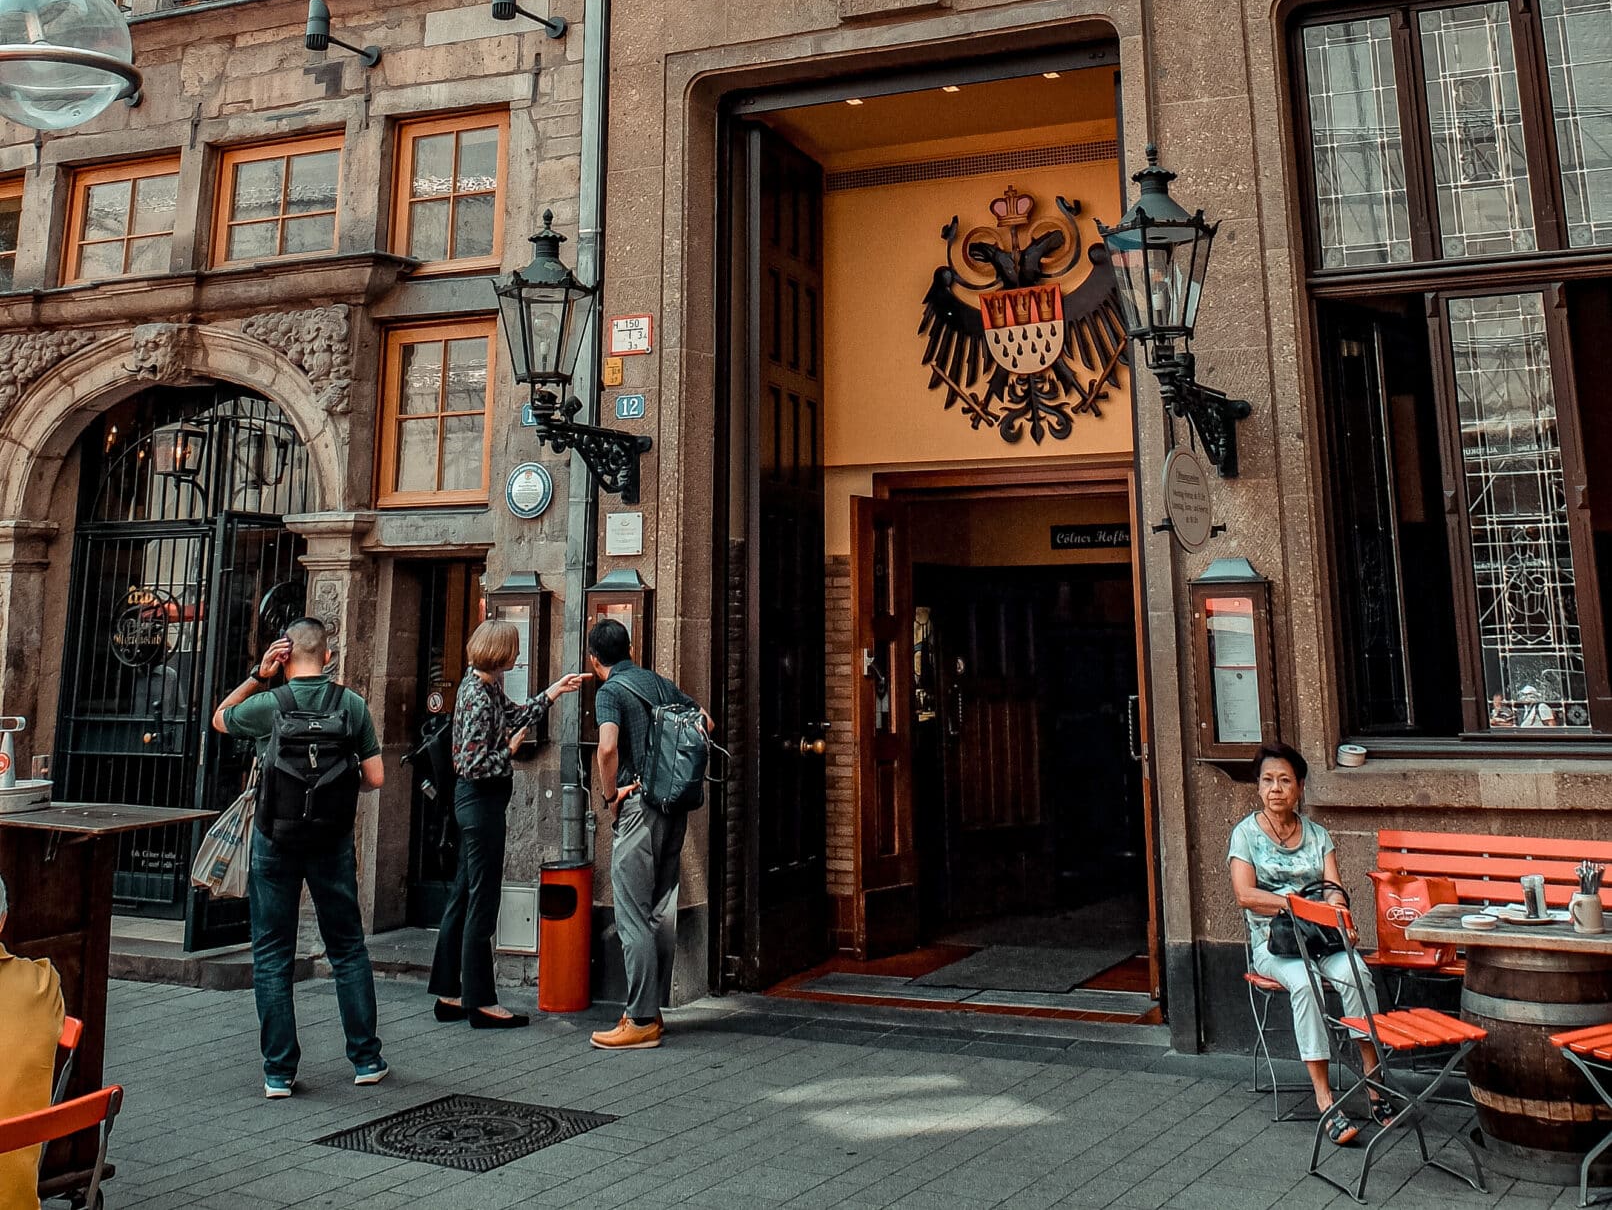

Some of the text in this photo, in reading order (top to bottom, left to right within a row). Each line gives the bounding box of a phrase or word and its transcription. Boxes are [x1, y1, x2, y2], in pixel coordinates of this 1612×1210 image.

[625, 319, 640, 328] 150
[622, 397, 639, 416] 12
[1056, 532, 1091, 544] Cölner
